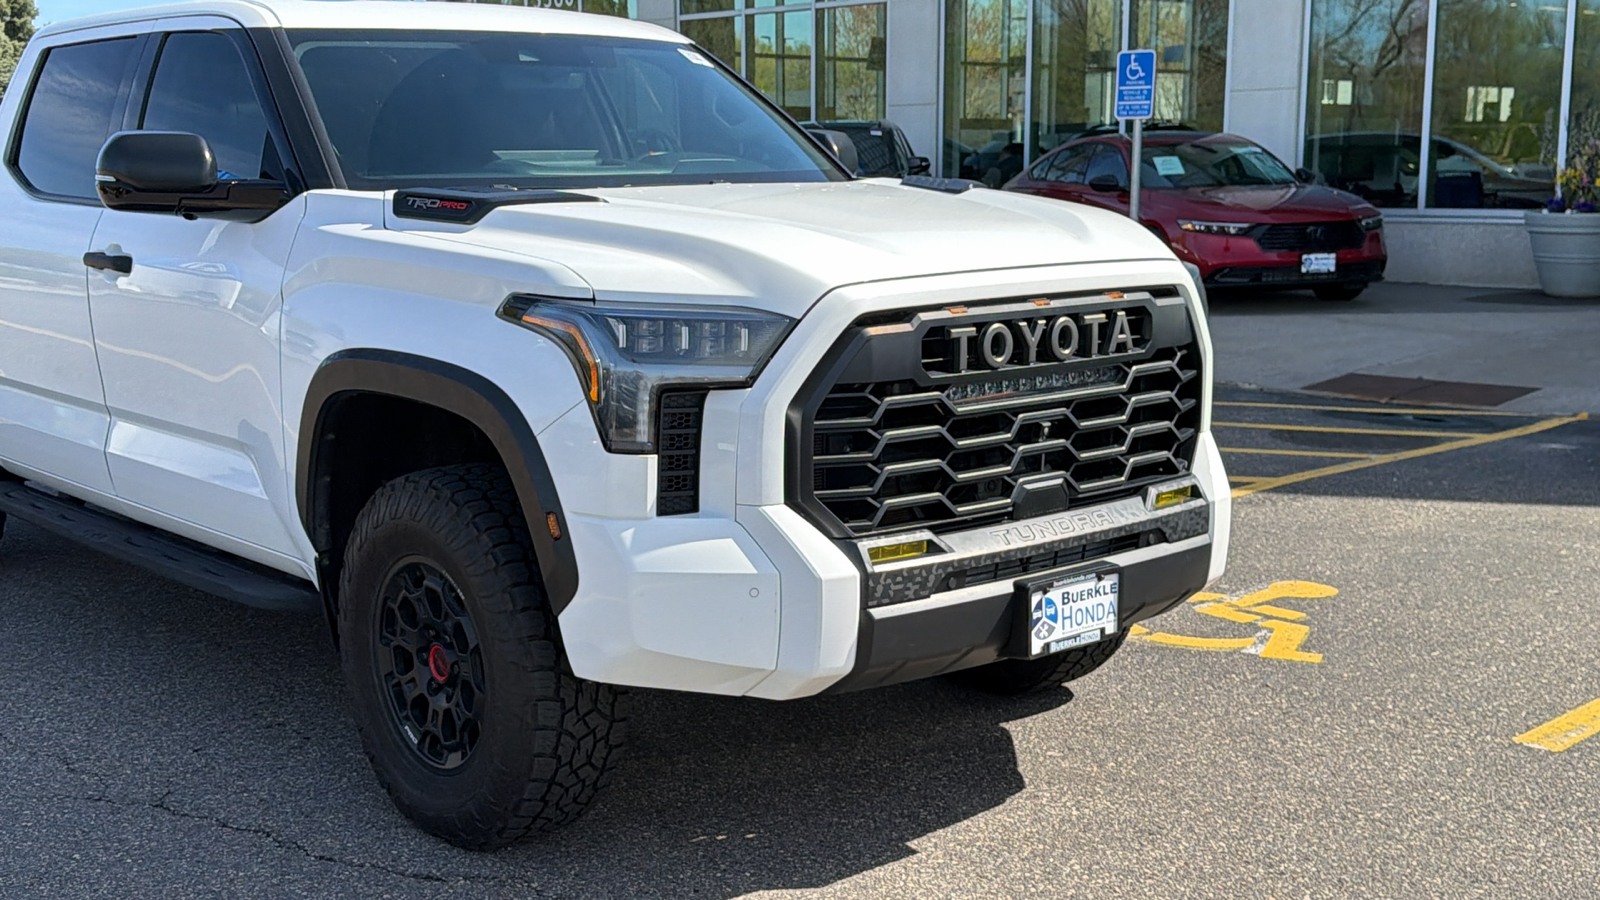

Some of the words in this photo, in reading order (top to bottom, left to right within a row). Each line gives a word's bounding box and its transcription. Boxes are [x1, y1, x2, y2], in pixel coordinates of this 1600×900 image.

[406, 196, 440, 210] TRD
[439, 200, 467, 210] PRO
[947, 310, 1135, 373] TOYOTA
[990, 509, 1114, 546] TUNDRA
[1062, 582, 1118, 606] BUERKLE
[1062, 600, 1117, 631] HONDA
